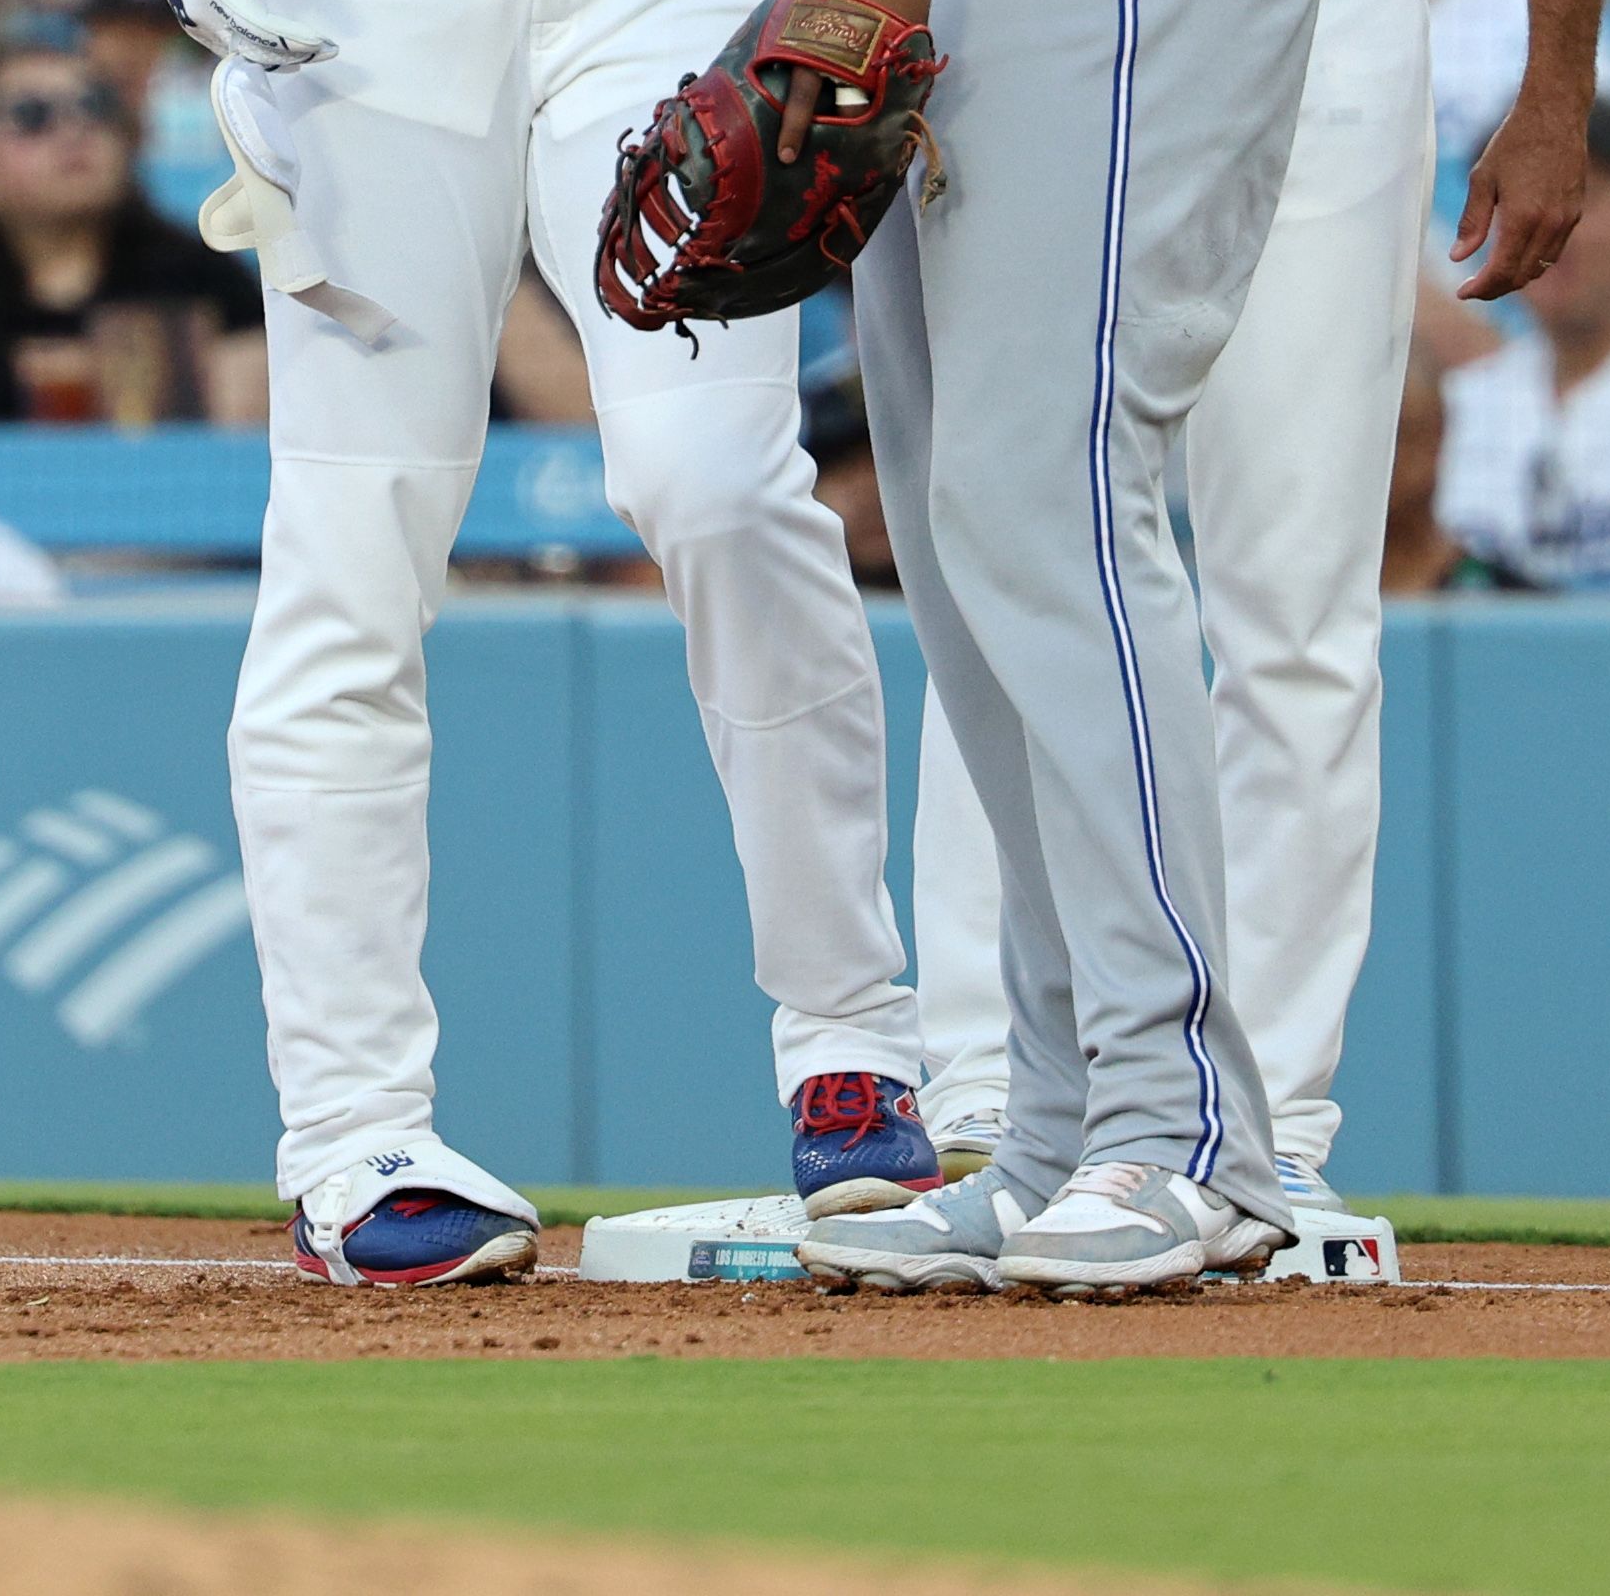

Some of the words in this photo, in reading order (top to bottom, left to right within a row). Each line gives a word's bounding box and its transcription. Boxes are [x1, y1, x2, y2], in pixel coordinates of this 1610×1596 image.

[209, 0, 230, 21] new
[230, 17, 279, 48] balance
[715, 1249, 732, 1266] LOS
